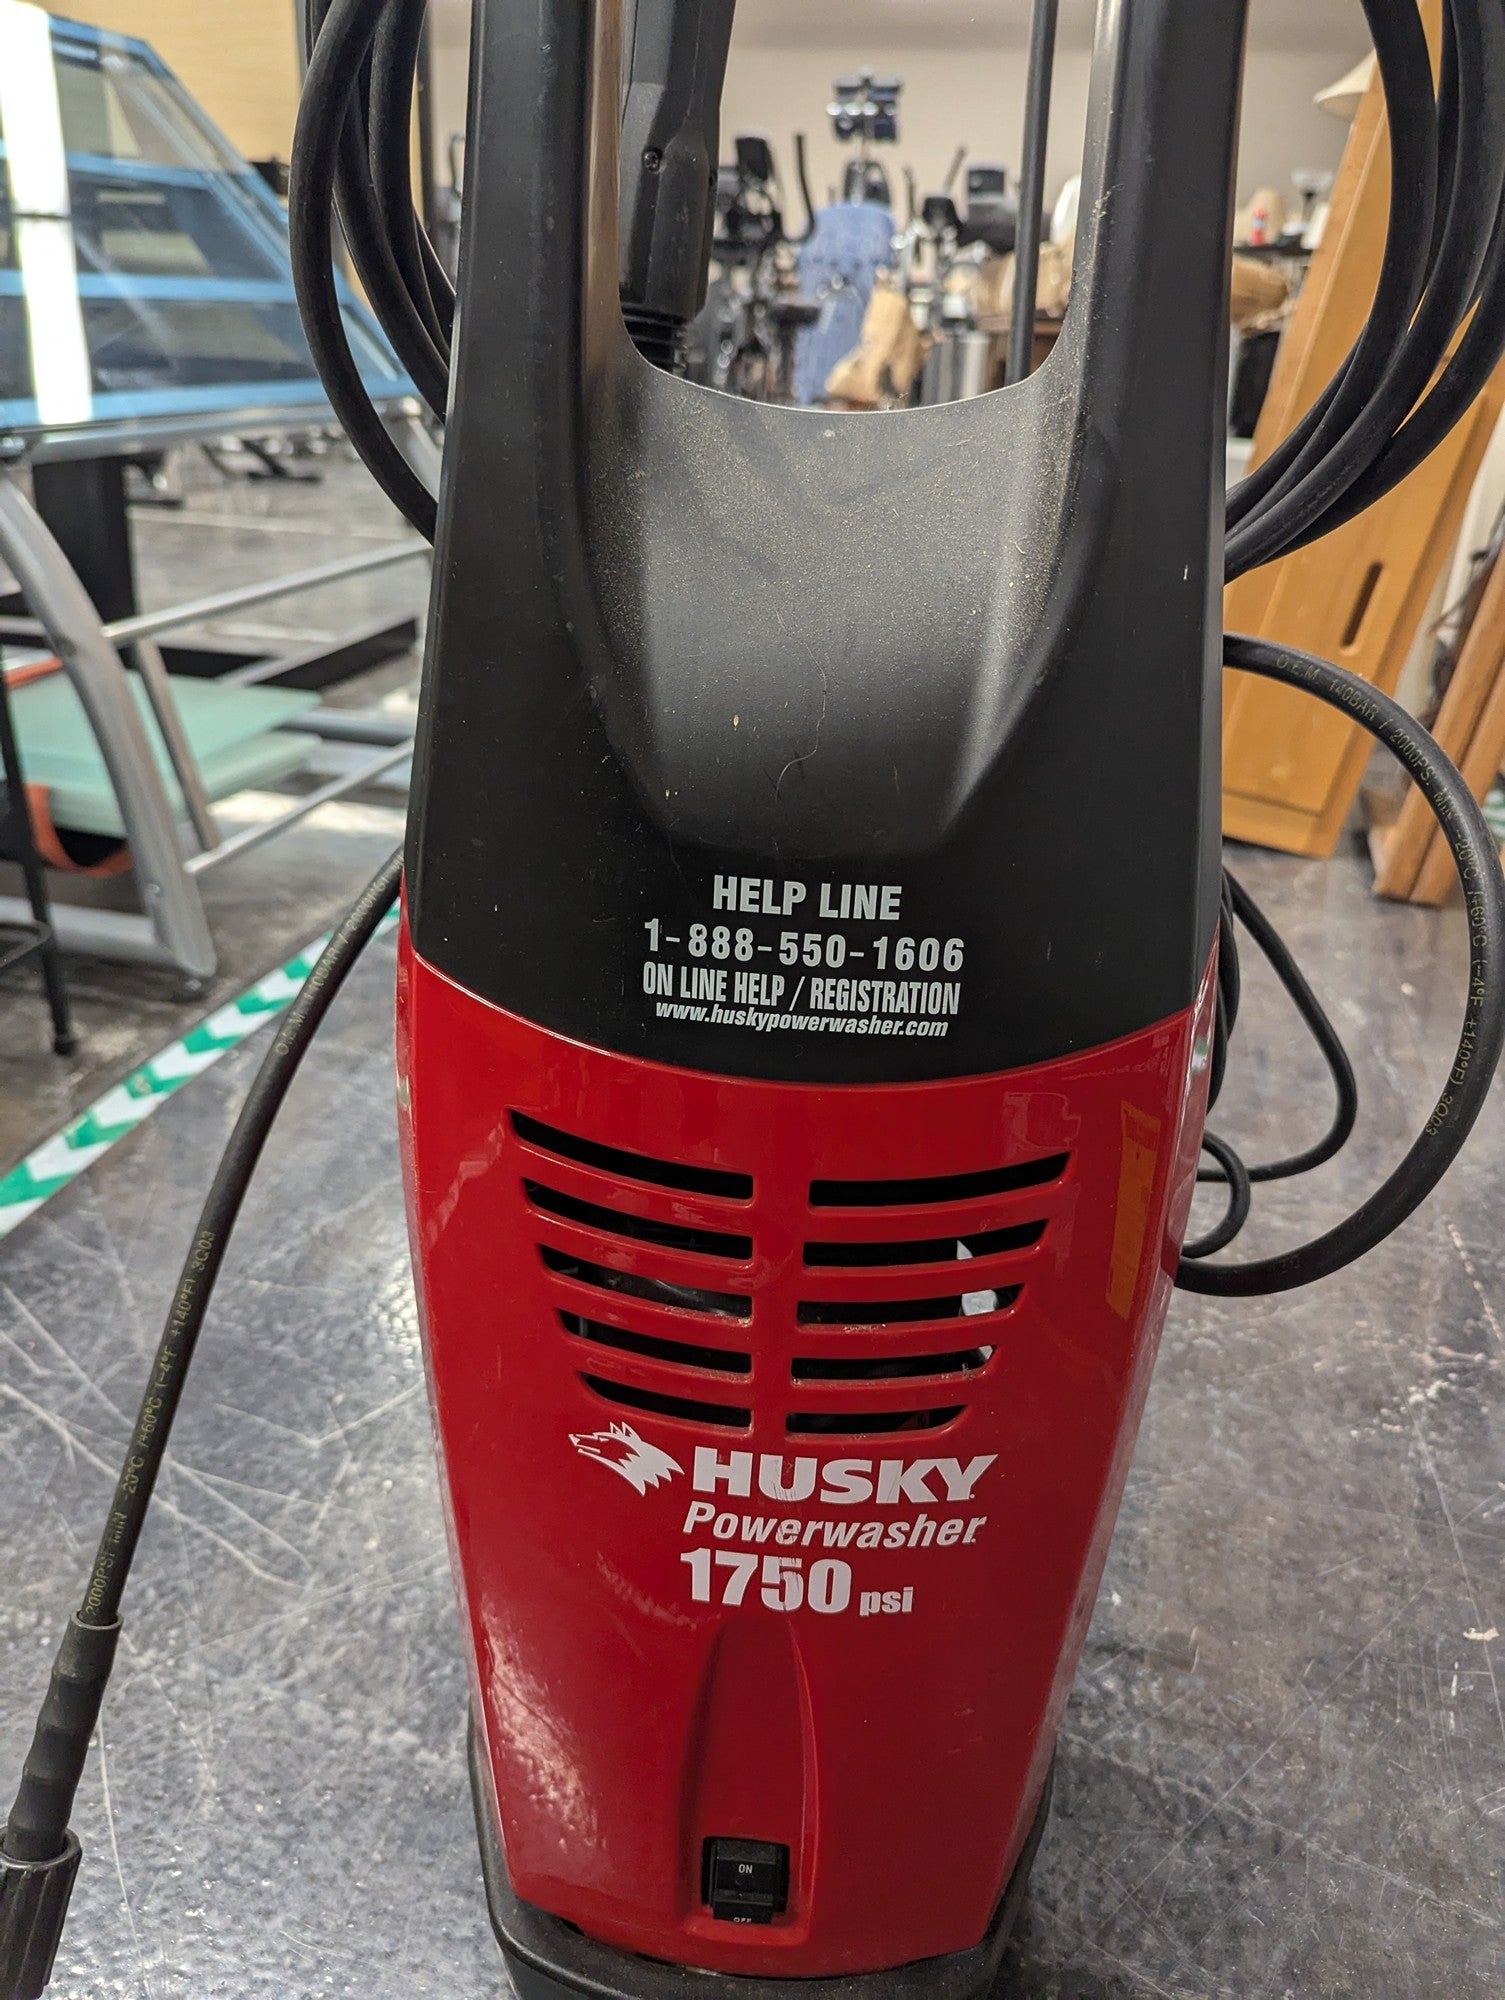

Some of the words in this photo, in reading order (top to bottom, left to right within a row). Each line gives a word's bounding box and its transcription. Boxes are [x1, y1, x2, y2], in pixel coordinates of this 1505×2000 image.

[712, 874, 807, 916] HELP
[819, 882, 902, 921] LINE
[644, 917, 966, 972] 1-888-550-1606
[642, 961, 675, 997] ON
[679, 965, 728, 1002] LINE
[733, 971, 785, 1007] HELP
[789, 975, 806, 1012] /
[809, 977, 962, 1015] REGISTRATION
[655, 1001, 949, 1037] www.huskypowerwasher.com
[692, 1445, 999, 1505] HUSKY
[682, 1500, 988, 1549] Powerwasher
[680, 1547, 852, 1614] 1750
[859, 1586, 914, 1617] psi
[738, 1863, 753, 1874] ON
